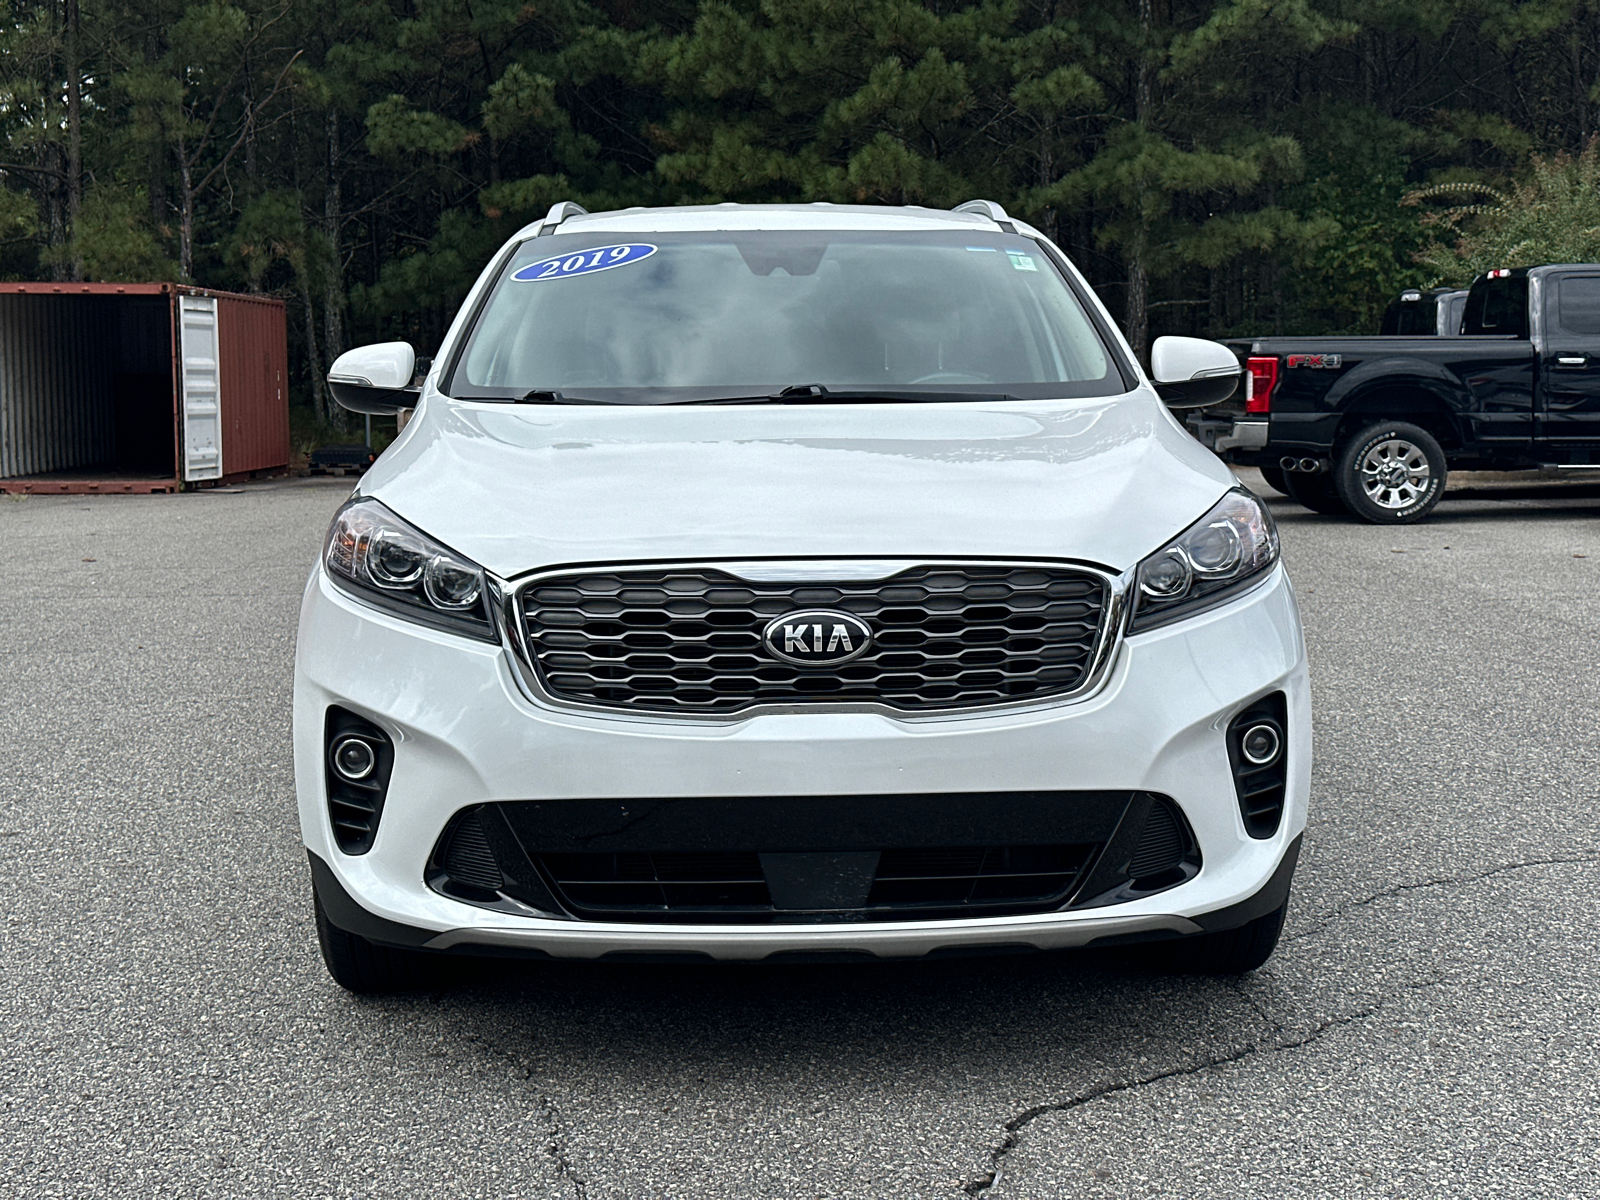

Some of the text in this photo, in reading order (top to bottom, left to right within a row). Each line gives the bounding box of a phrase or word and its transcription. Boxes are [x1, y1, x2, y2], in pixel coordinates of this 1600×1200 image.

[537, 246, 631, 278] 2019
[1287, 354, 1341, 368] FX4
[783, 624, 854, 652] KIA
